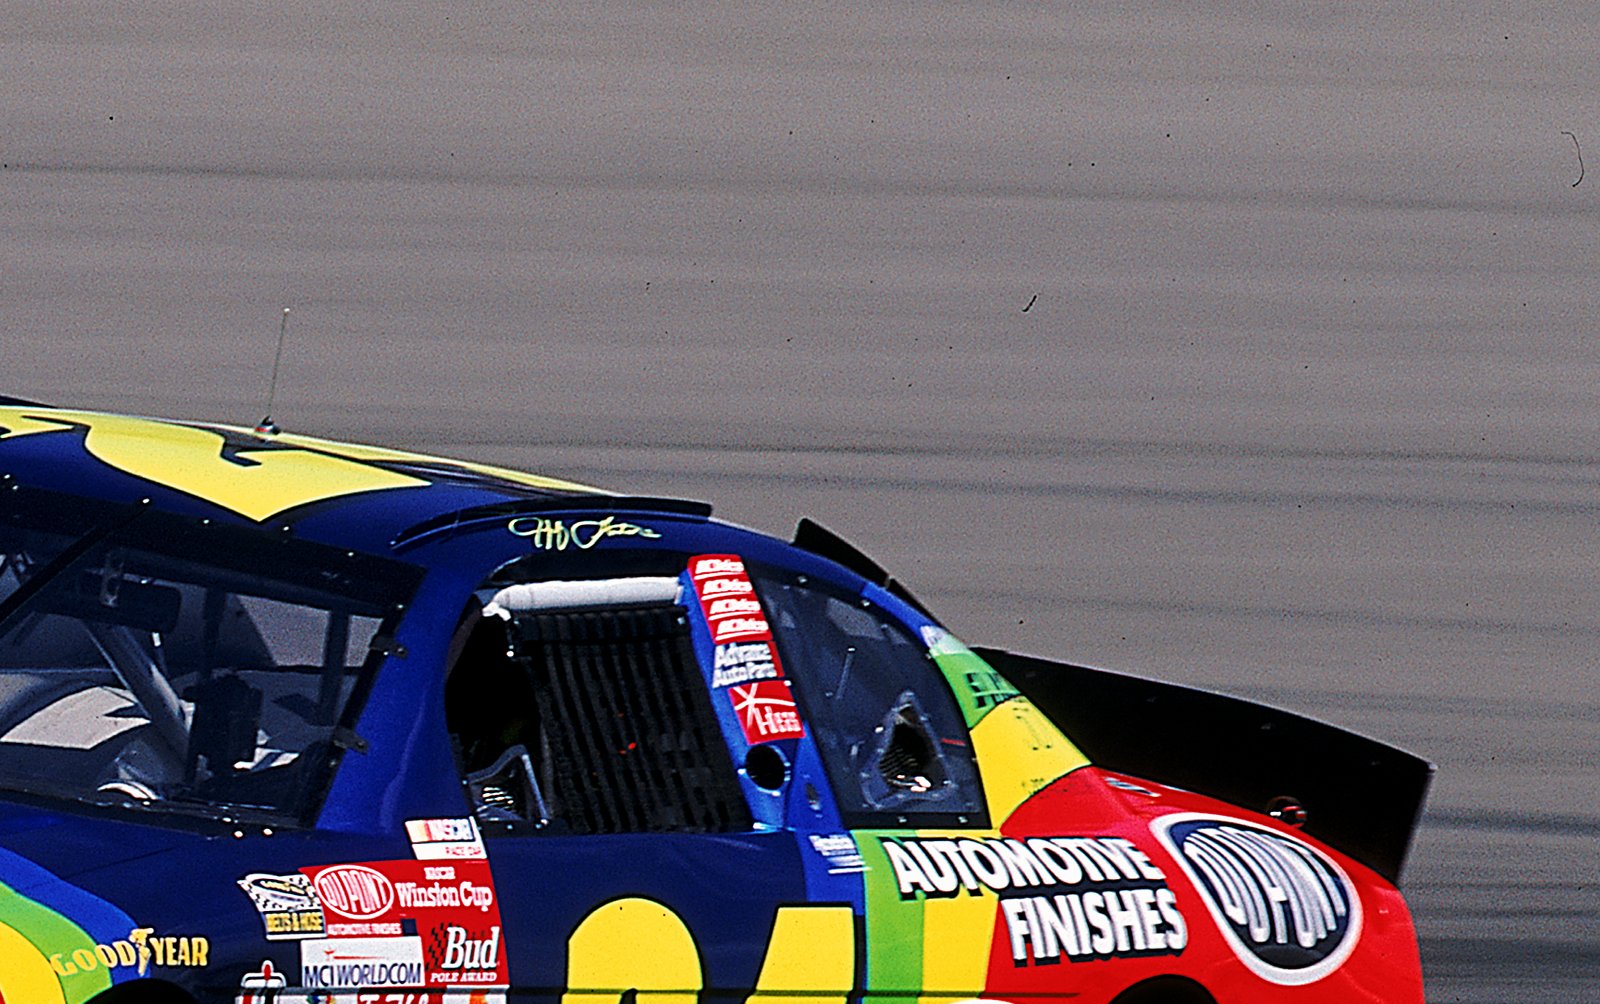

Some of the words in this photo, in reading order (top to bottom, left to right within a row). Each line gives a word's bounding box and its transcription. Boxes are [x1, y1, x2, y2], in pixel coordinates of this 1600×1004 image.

[880, 836, 1167, 896] AUTOMOTIVE
[394, 882, 460, 907] Winston
[460, 881, 493, 912] Cup
[1000, 887, 1189, 962] FINISHES
[50, 928, 209, 977] GOODYEAR
[441, 926, 500, 970] Bud
[430, 972, 458, 983] POLE
[459, 972, 497, 982] AWARD
